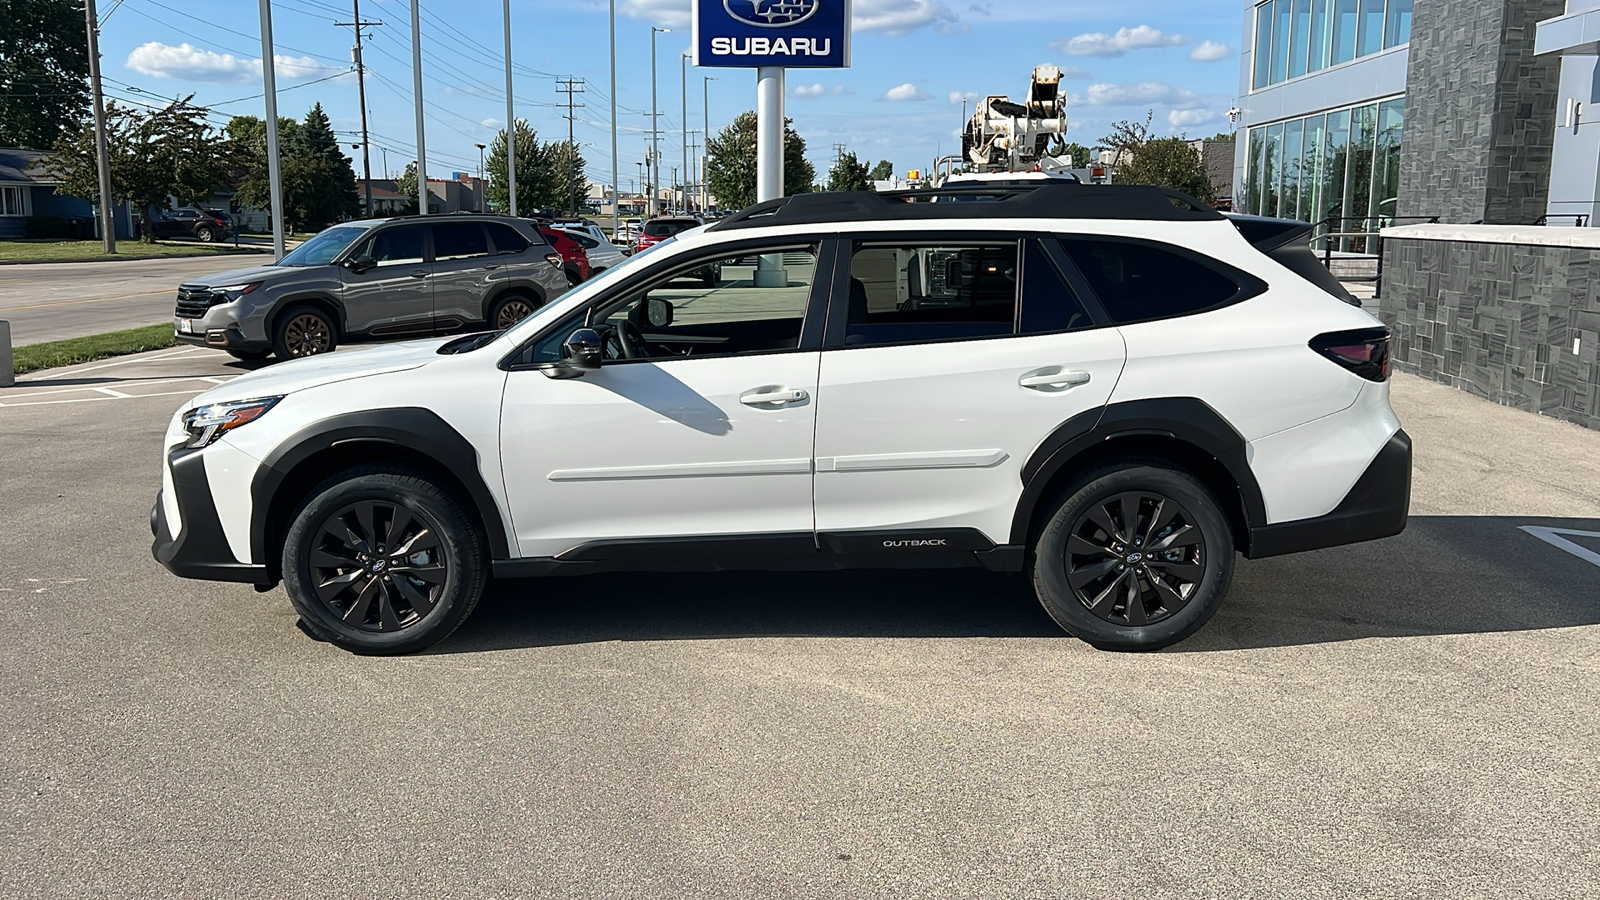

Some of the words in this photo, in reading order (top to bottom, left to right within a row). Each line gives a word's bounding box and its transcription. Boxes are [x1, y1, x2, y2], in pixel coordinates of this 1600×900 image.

[711, 37, 831, 56] SUBARU
[1049, 481, 1104, 536] YOKOHAMA
[882, 539, 947, 547] OUTBACK
